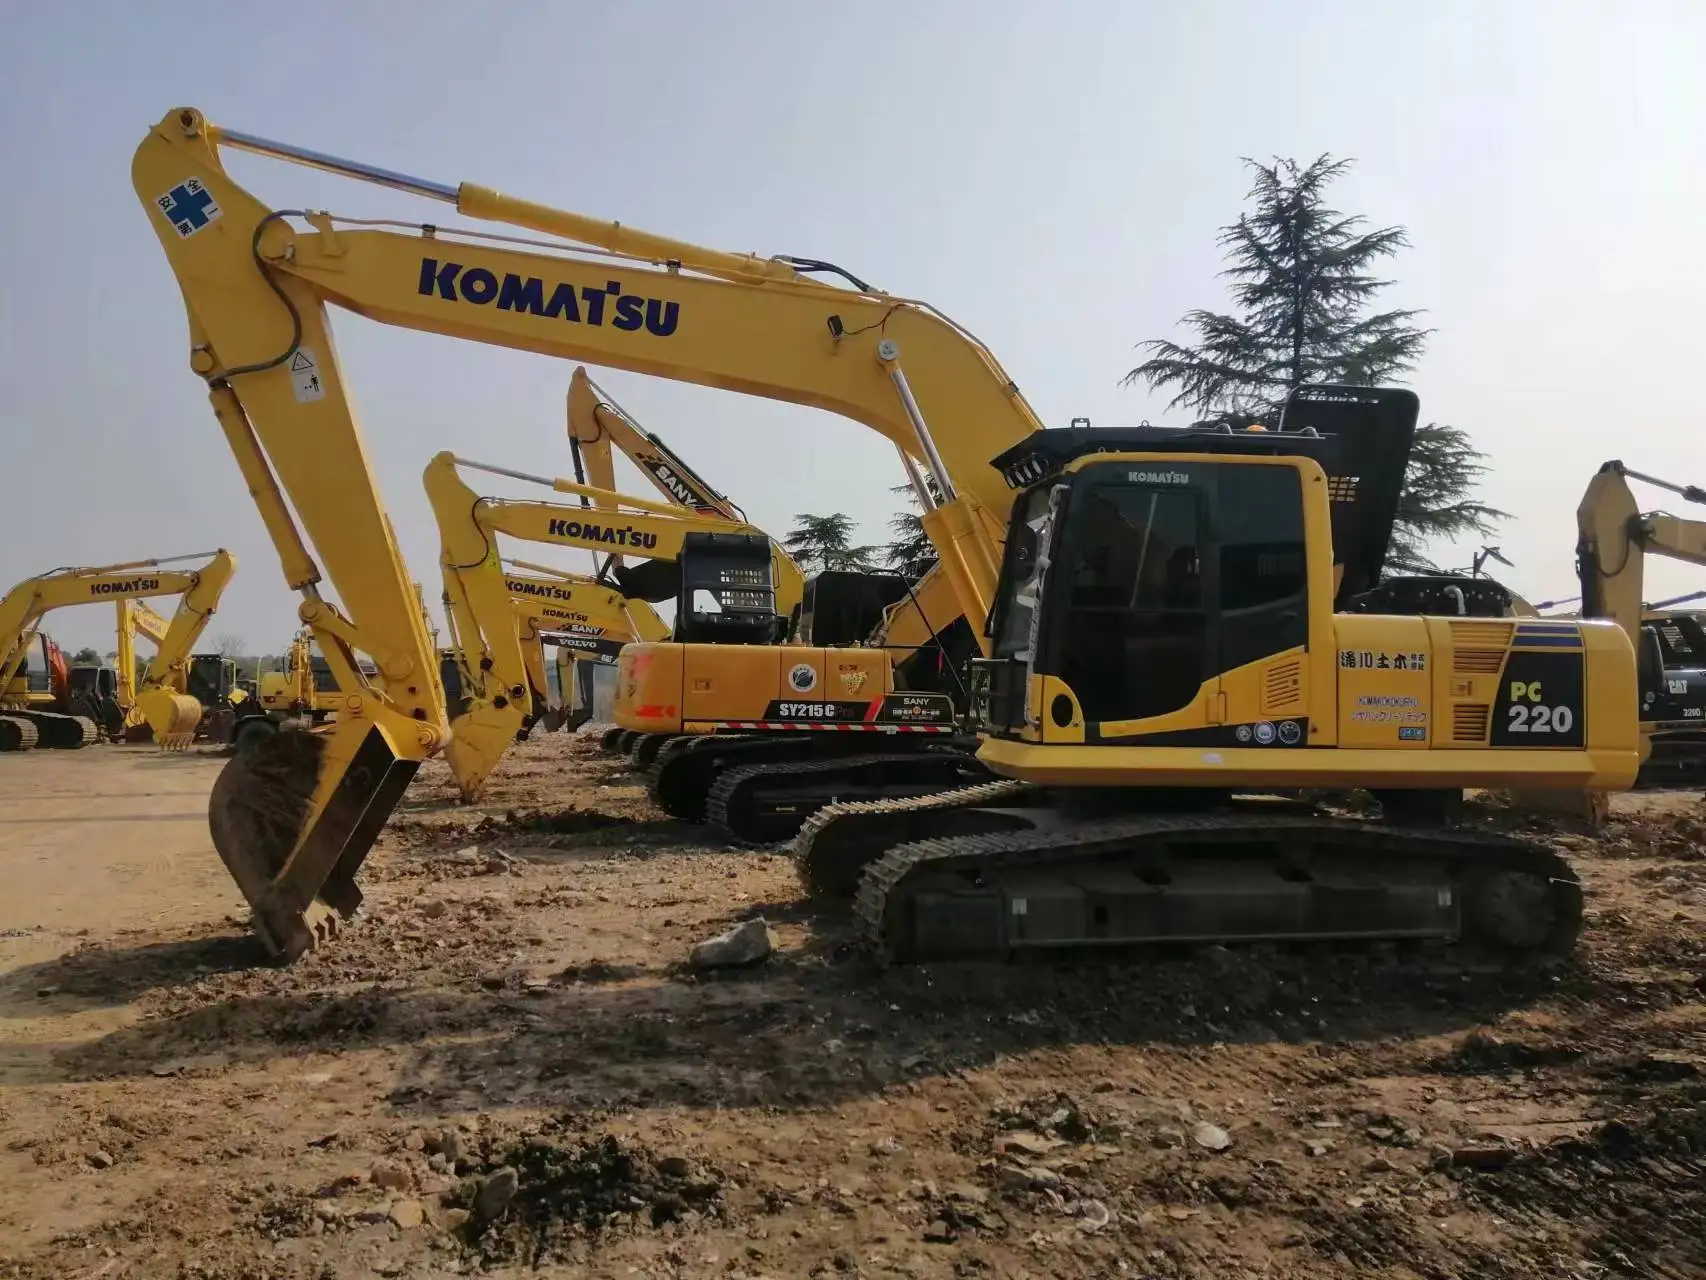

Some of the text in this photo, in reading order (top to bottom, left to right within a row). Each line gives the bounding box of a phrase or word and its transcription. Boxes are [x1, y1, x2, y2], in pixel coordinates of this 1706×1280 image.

[418, 257, 680, 337] KOMATSU
[655, 465, 698, 505] SANY
[1128, 470, 1189, 484] KOMATSU
[548, 518, 658, 549] KOMATSU
[90, 577, 159, 595] KOMATSU
[505, 580, 572, 600] KOMATSU
[542, 608, 589, 622] KOMATSU
[571, 624, 601, 634] SANY
[559, 639, 597, 648] VOLVO
[1510, 681, 1542, 702] PC
[903, 697, 930, 706] SANY
[1508, 704, 1573, 733] 220
